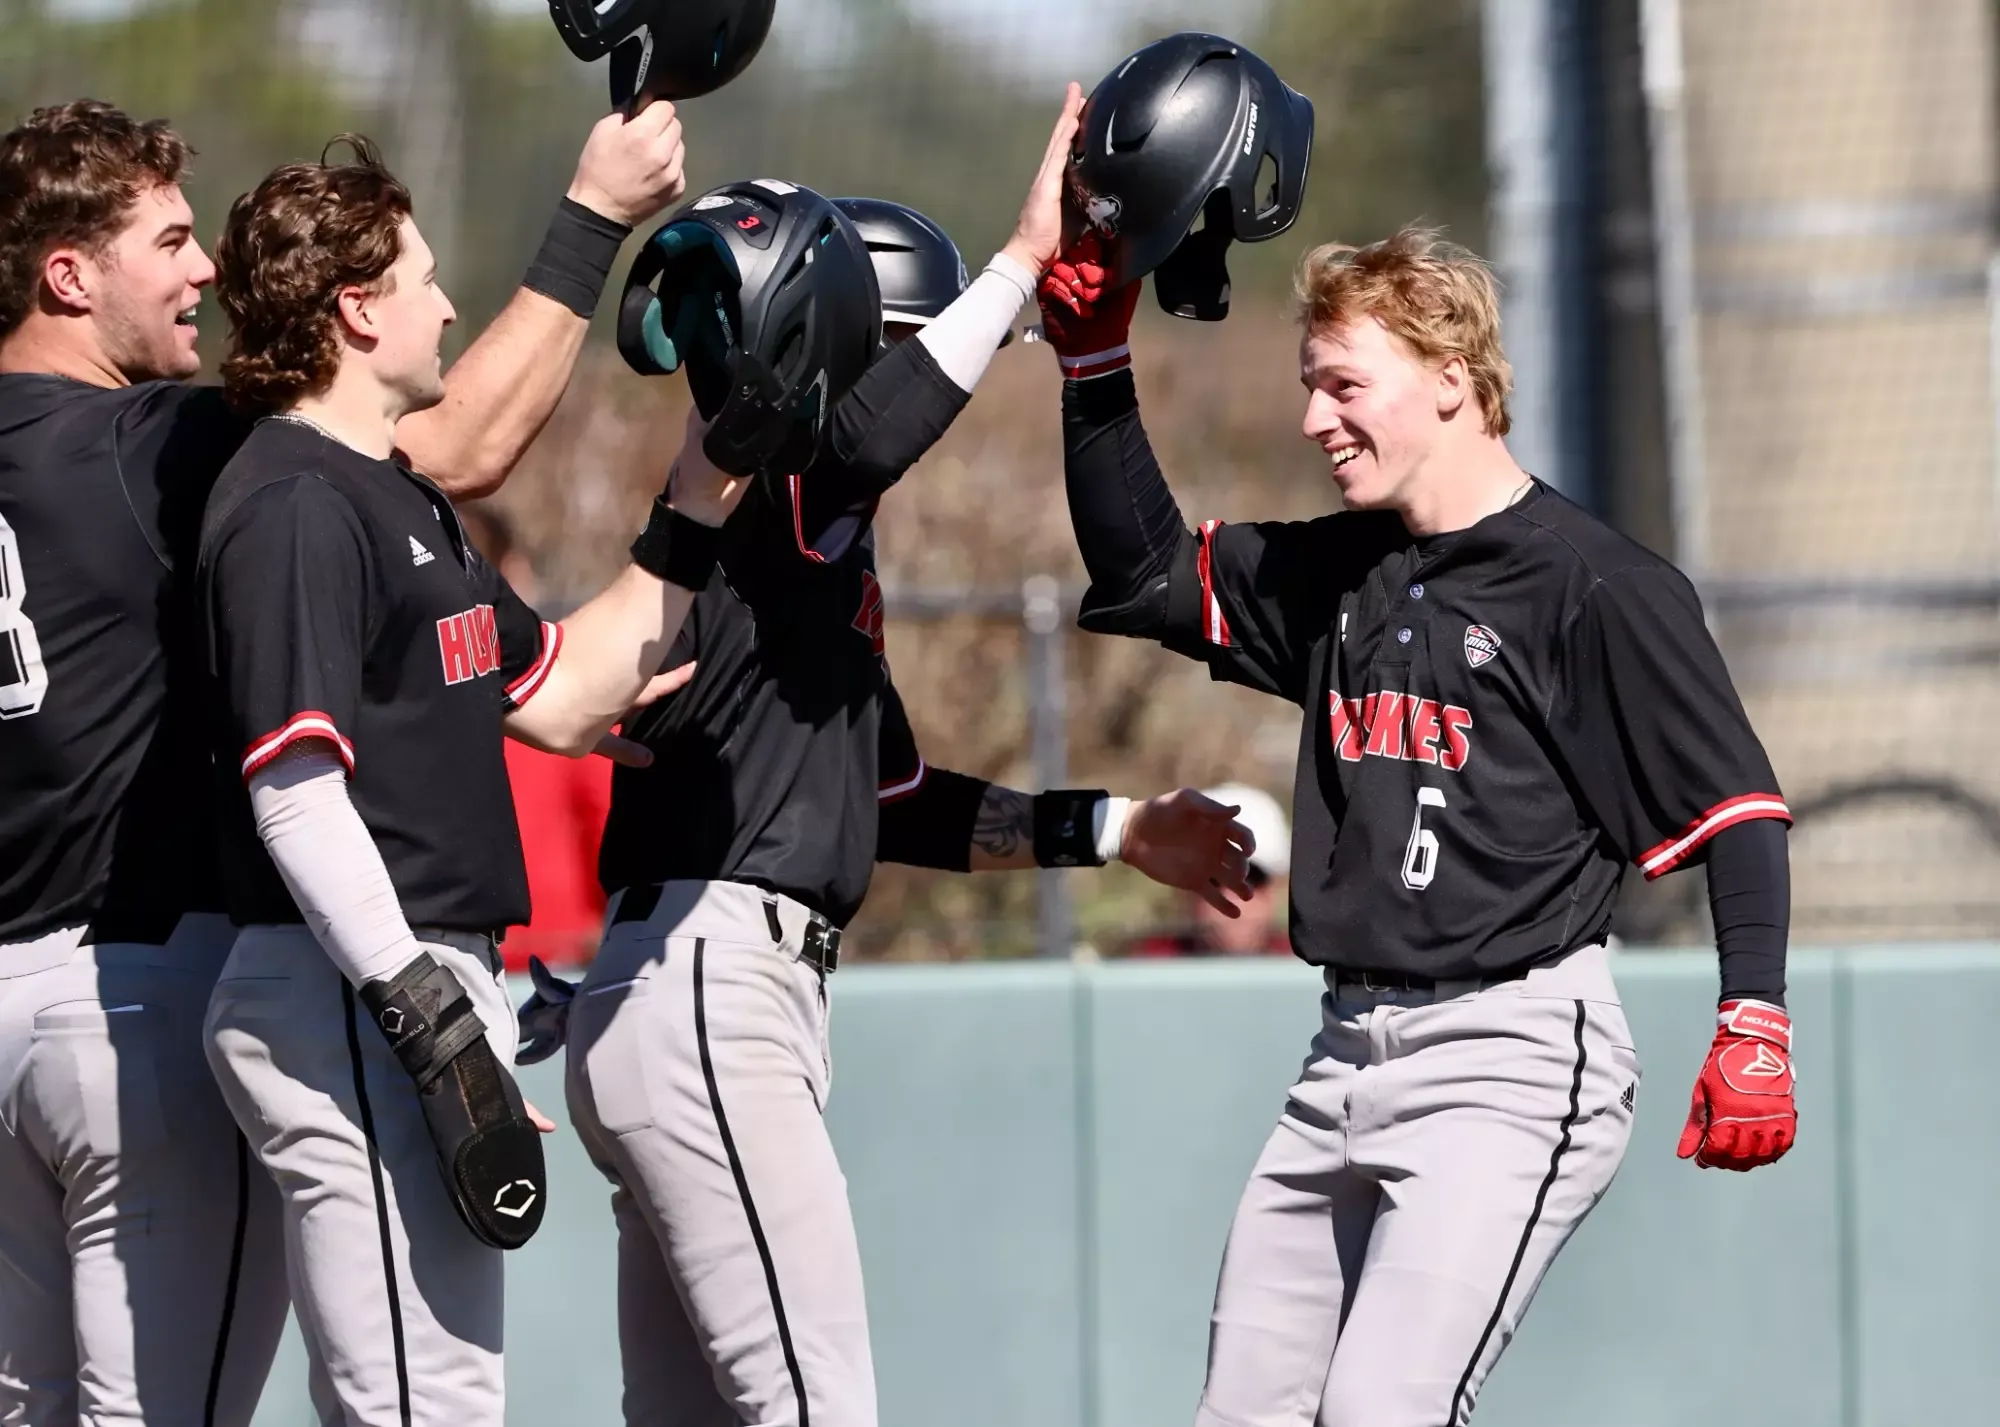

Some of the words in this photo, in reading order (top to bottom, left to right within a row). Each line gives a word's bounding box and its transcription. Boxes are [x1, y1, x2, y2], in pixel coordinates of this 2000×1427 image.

[1243, 102, 1258, 155] EASTON
[736, 215, 760, 229] 3
[413, 552, 435, 566] adidas
[1401, 786, 1447, 891] 6
